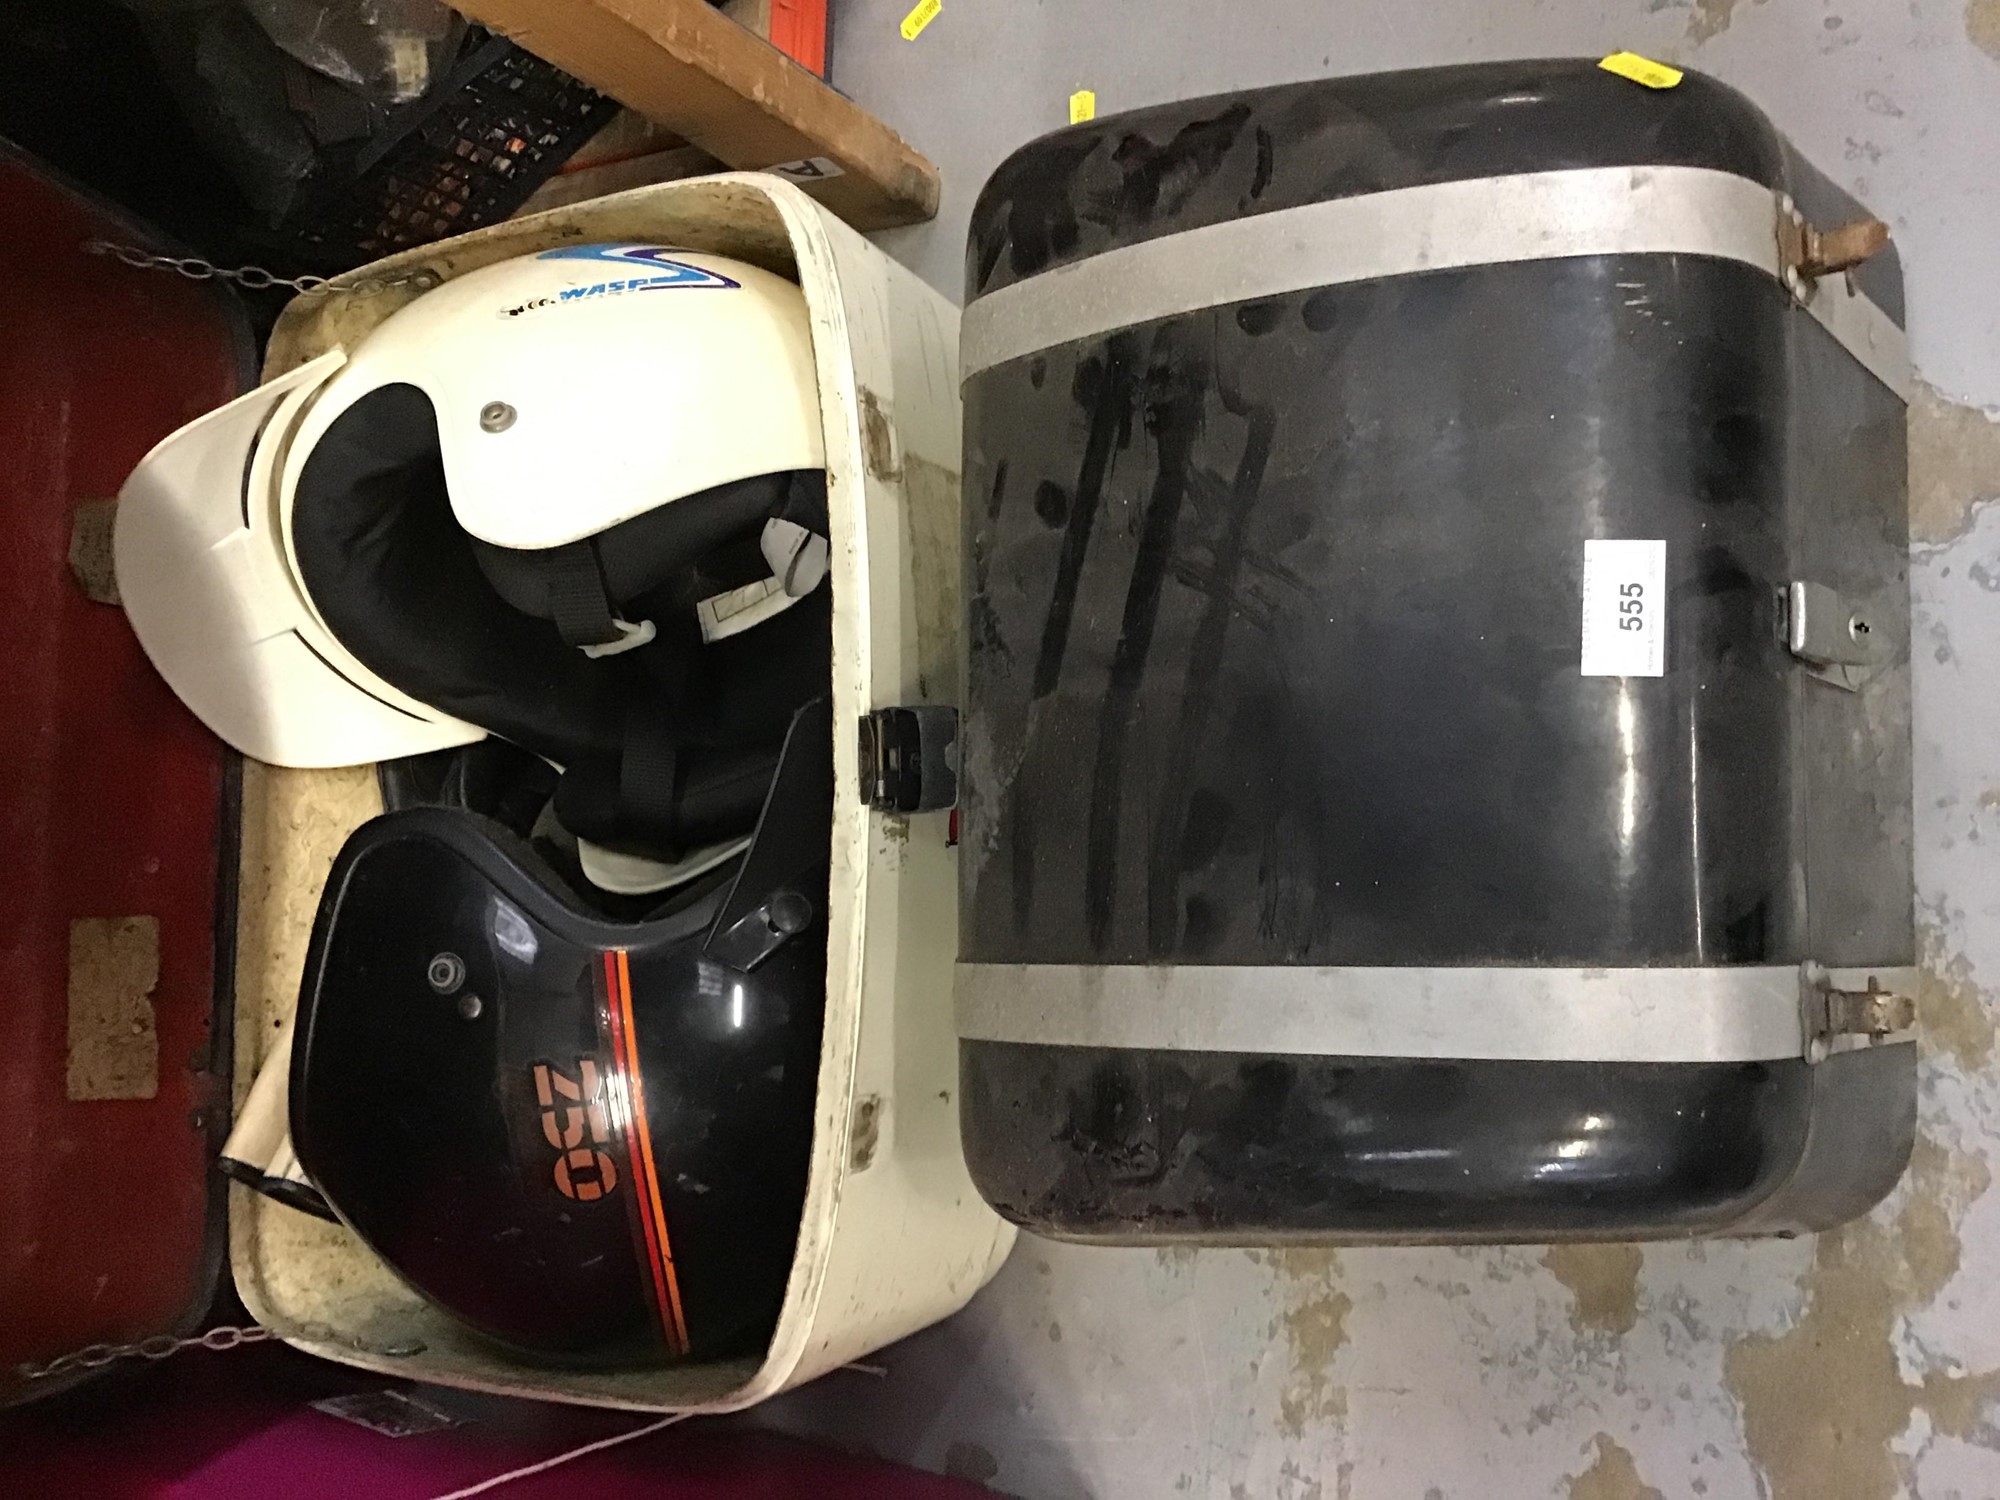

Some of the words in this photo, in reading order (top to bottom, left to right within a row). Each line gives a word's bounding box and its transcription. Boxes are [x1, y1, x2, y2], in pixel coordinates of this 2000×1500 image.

[560, 278, 649, 300] WASP
[1619, 583, 1644, 632] 555
[532, 1059, 618, 1201] 250
